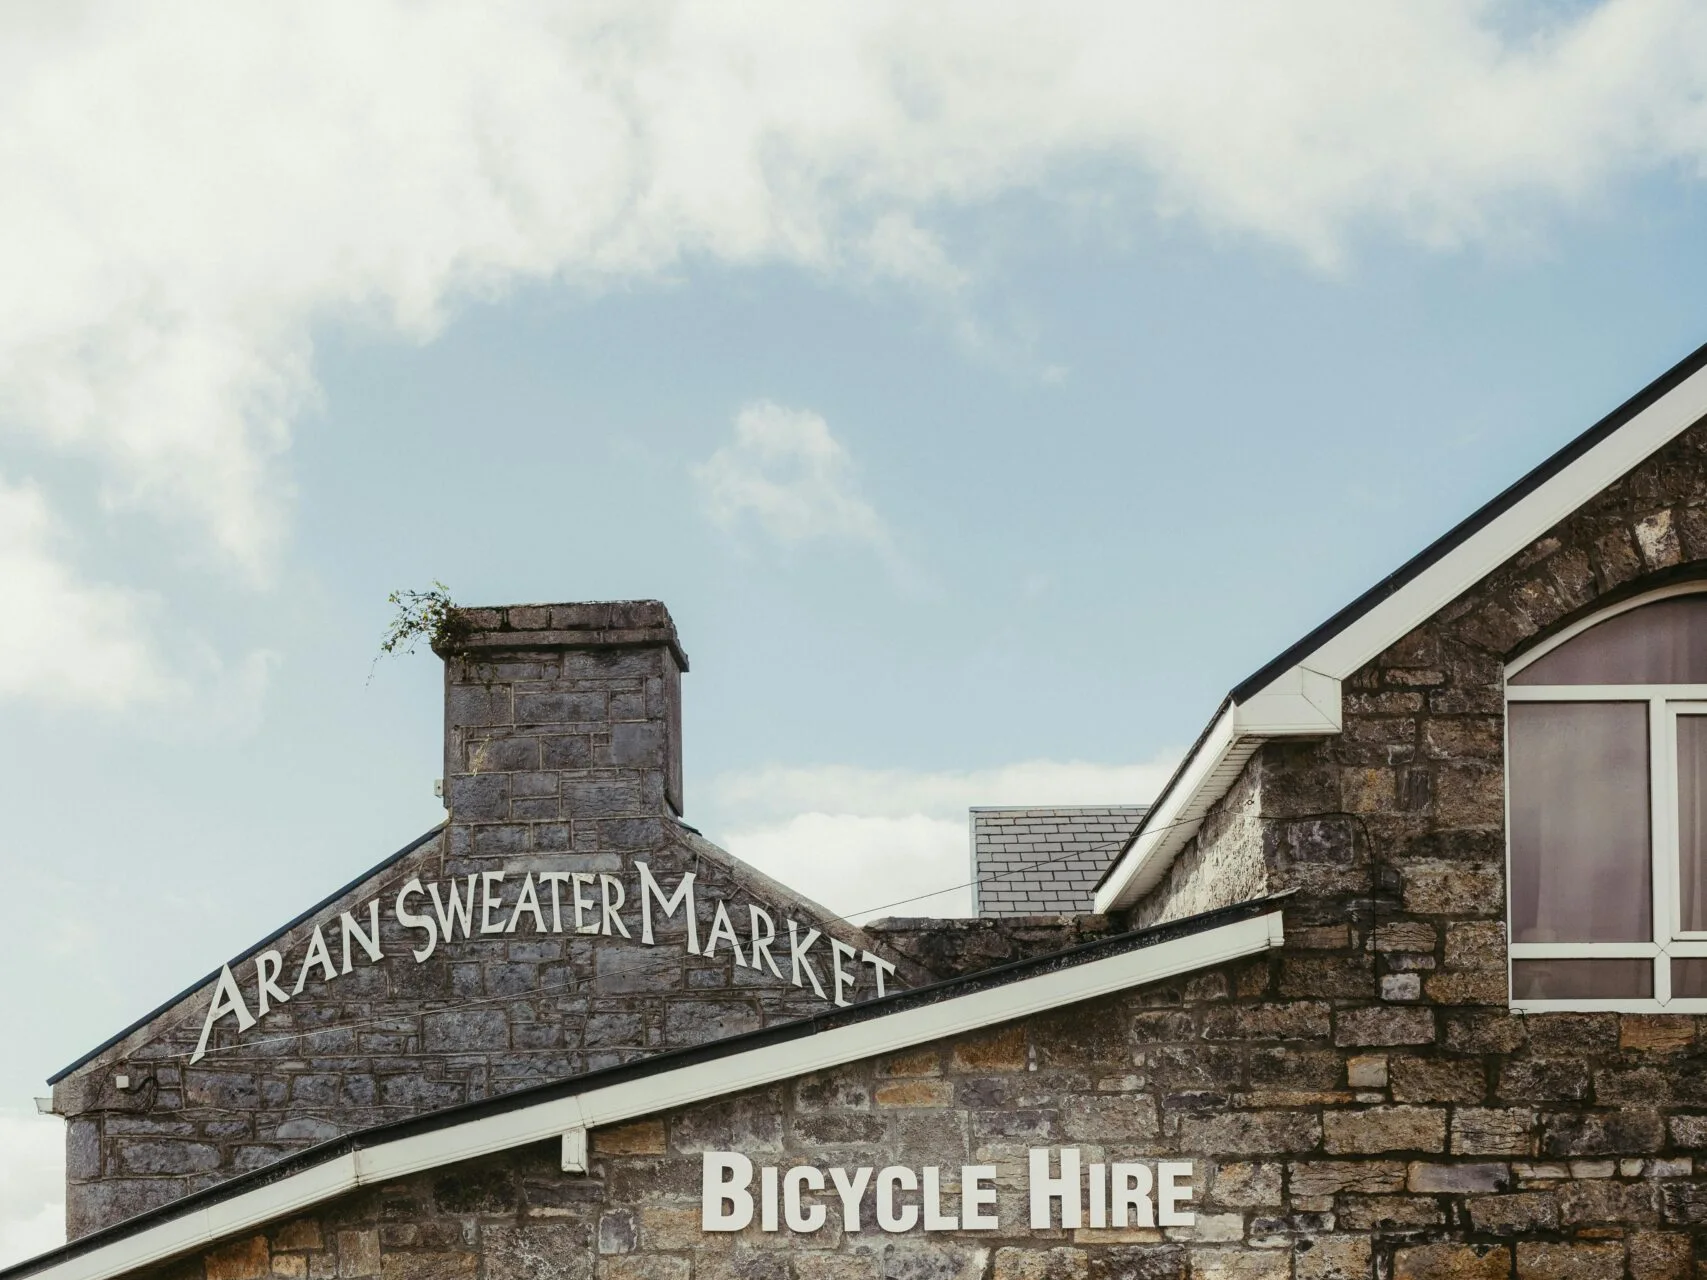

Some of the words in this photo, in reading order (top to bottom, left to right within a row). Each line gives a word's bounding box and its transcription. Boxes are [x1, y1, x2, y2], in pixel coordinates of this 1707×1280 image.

[190, 898, 385, 1065] ARAN
[396, 870, 633, 963] SWEATER
[634, 861, 896, 1008] MARKET
[702, 1151, 999, 1233] BICYCLE
[1029, 1148, 1196, 1229] HIRE
